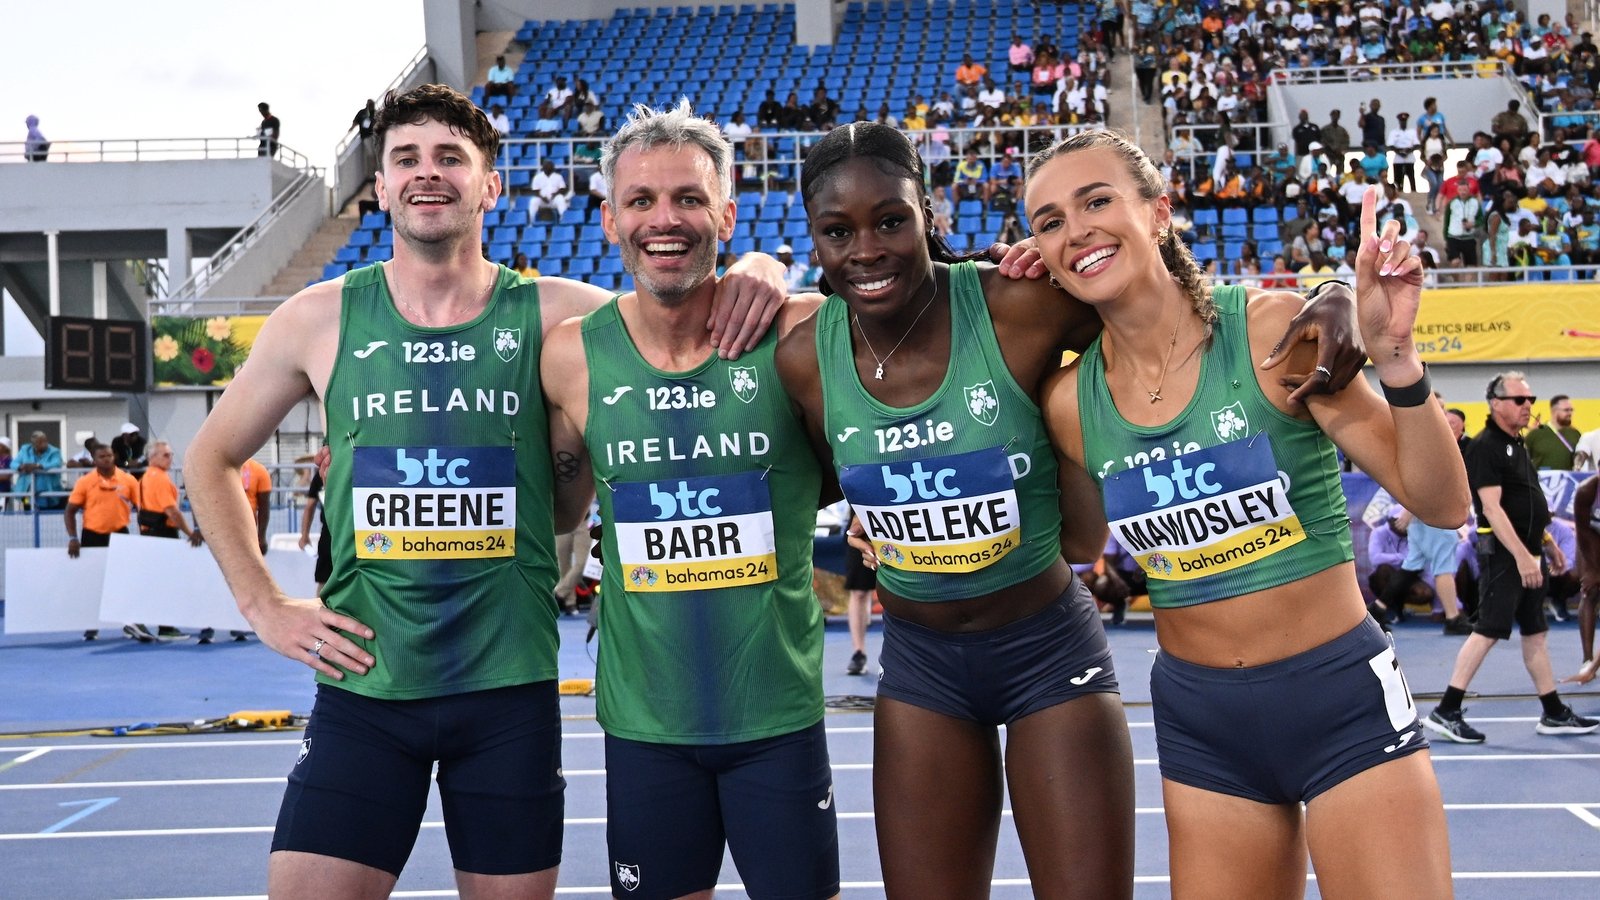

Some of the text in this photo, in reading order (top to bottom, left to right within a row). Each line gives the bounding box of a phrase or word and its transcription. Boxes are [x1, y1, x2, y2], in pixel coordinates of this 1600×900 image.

[1412, 321, 1511, 334] HLETICS RELAYS
[402, 341, 476, 363] 123.ie
[353, 388, 520, 420] IRELAND
[646, 386, 716, 410] 123.ie
[606, 432, 770, 466] IRELAND
[874, 419, 954, 454] 123.ie
[396, 448, 470, 486] btc
[881, 461, 961, 503] btc
[1143, 459, 1223, 508] btc
[366, 493, 504, 527] GREENE
[649, 481, 722, 520] btc
[866, 497, 1011, 543] ADELEKE
[1119, 486, 1279, 552] MAWDSLEY
[644, 522, 742, 561] BARR
